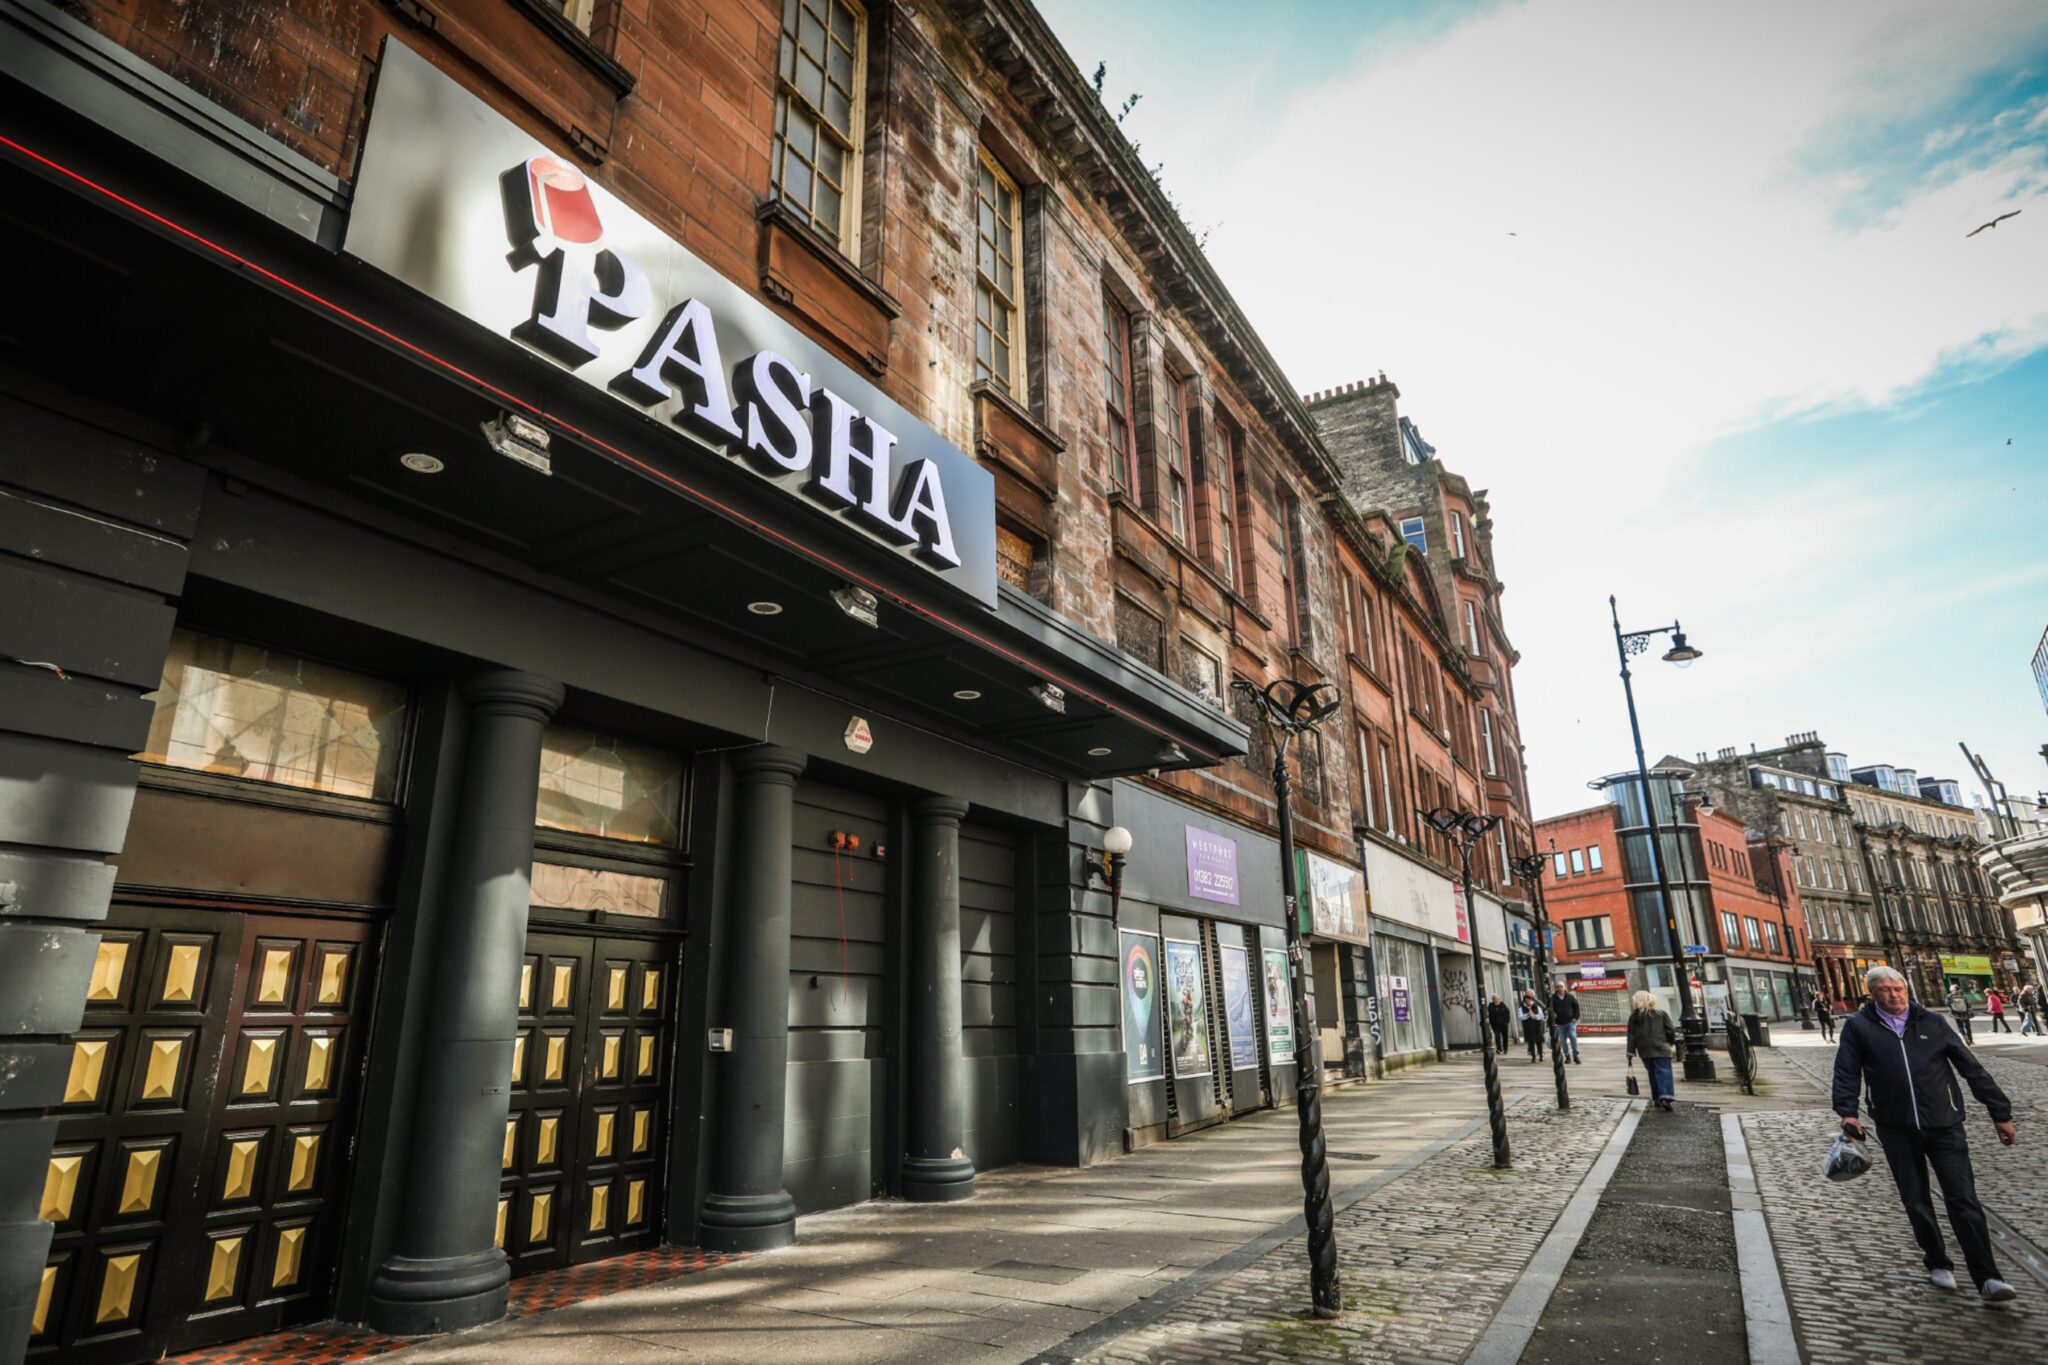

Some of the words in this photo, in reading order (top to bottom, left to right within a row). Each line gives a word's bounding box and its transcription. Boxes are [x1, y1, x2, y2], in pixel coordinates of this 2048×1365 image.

[514, 240, 961, 571] PASHA
[1192, 838, 1231, 859] WESTPORT
[1193, 869, 1213, 886] 01382
